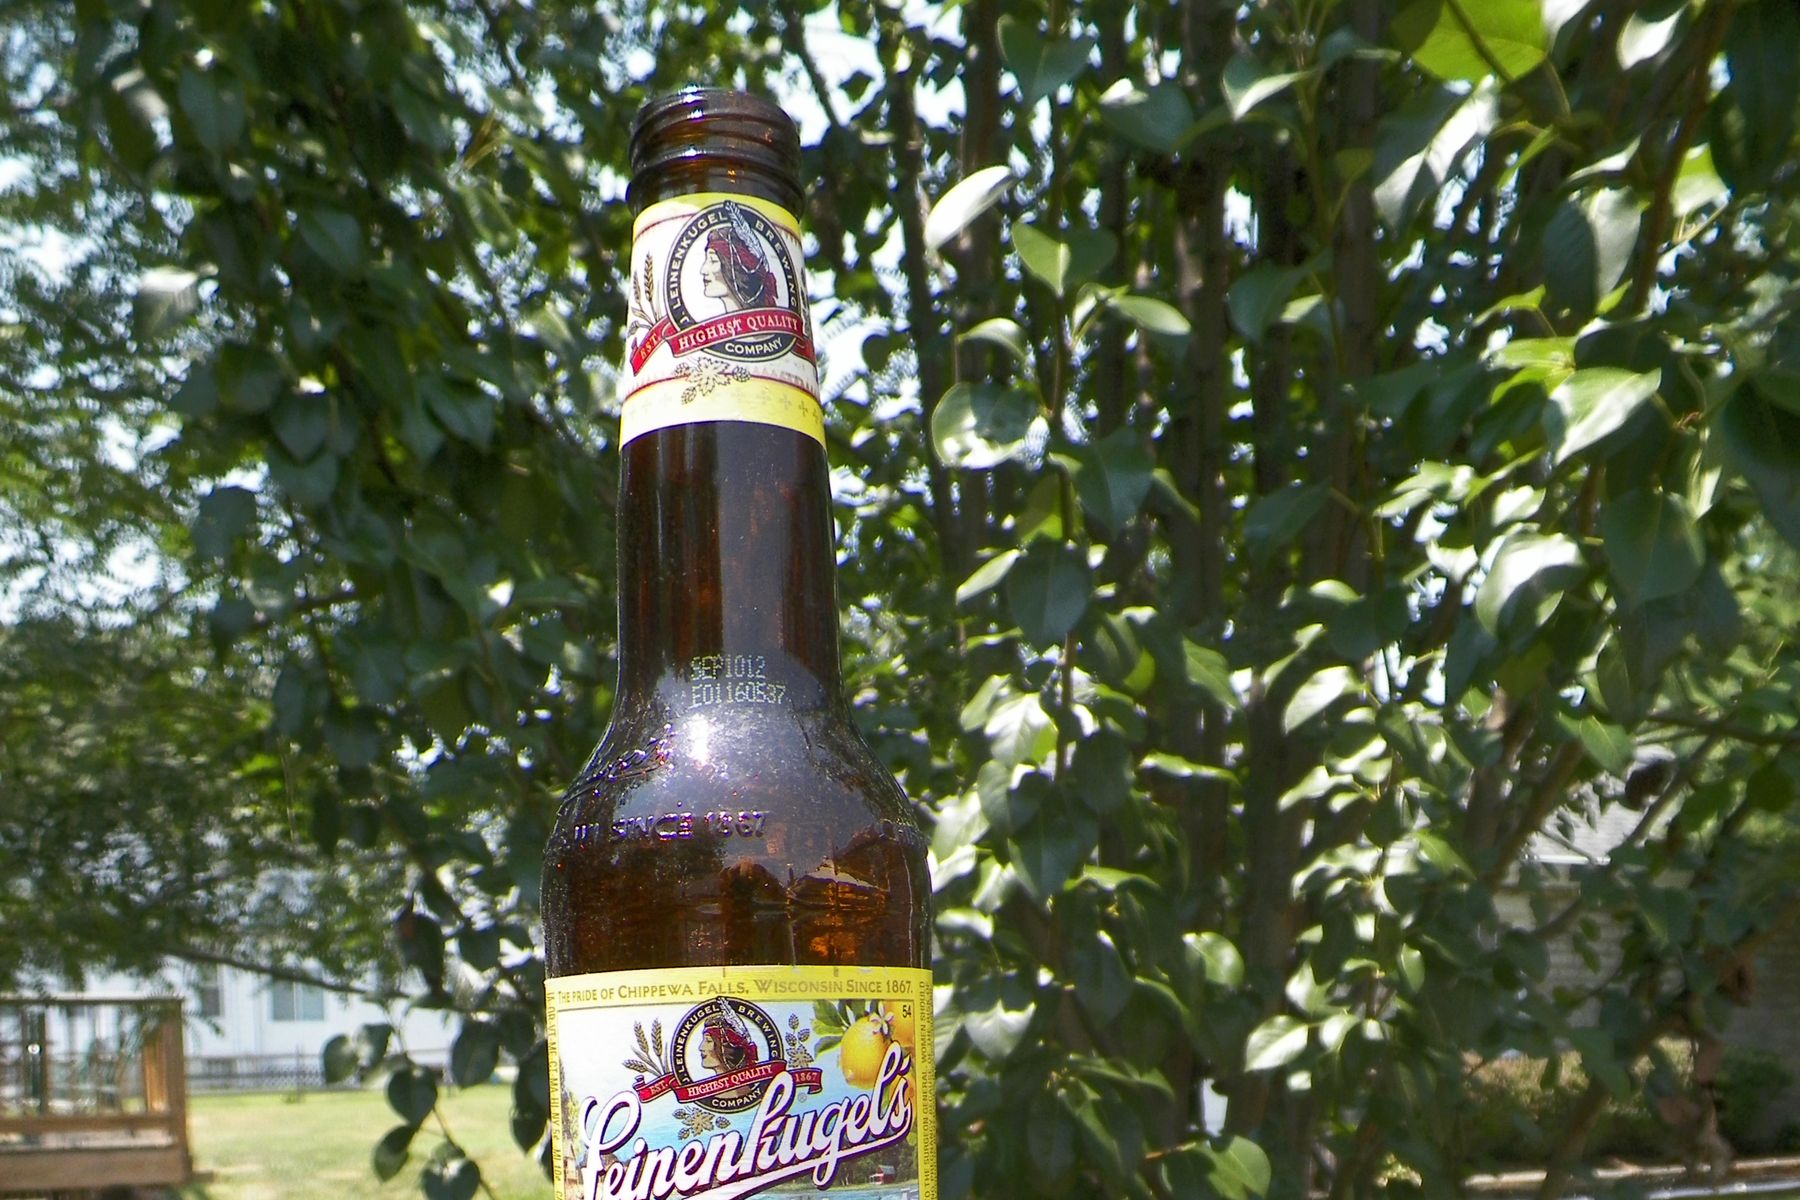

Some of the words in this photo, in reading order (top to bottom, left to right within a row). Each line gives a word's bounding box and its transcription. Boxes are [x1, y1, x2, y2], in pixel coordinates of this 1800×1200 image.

[668, 211, 728, 309] LEINENKUGEL
[755, 219, 798, 307] BREWING
[678, 318, 742, 351] HIGHEST
[748, 315, 799, 336] QUALITY
[725, 338, 783, 356] COMPANY
[572, 989, 597, 1002] PRIDE
[600, 988, 614, 1000] OF
[618, 983, 694, 999] CHIPPEWA
[753, 979, 843, 993] WISCONSIN
[846, 979, 882, 993] SINCE
[902, 1004, 912, 1019] 54
[675, 1005, 720, 1073] LEINENKUGEL
[738, 1004, 779, 1058] BREWING
[650, 1080, 669, 1096] EST.
[687, 1077, 732, 1098] HIGHEST
[731, 1064, 773, 1084] QUALITY
[795, 1073, 818, 1083] 1867
[711, 1089, 763, 1108] COMPANY
